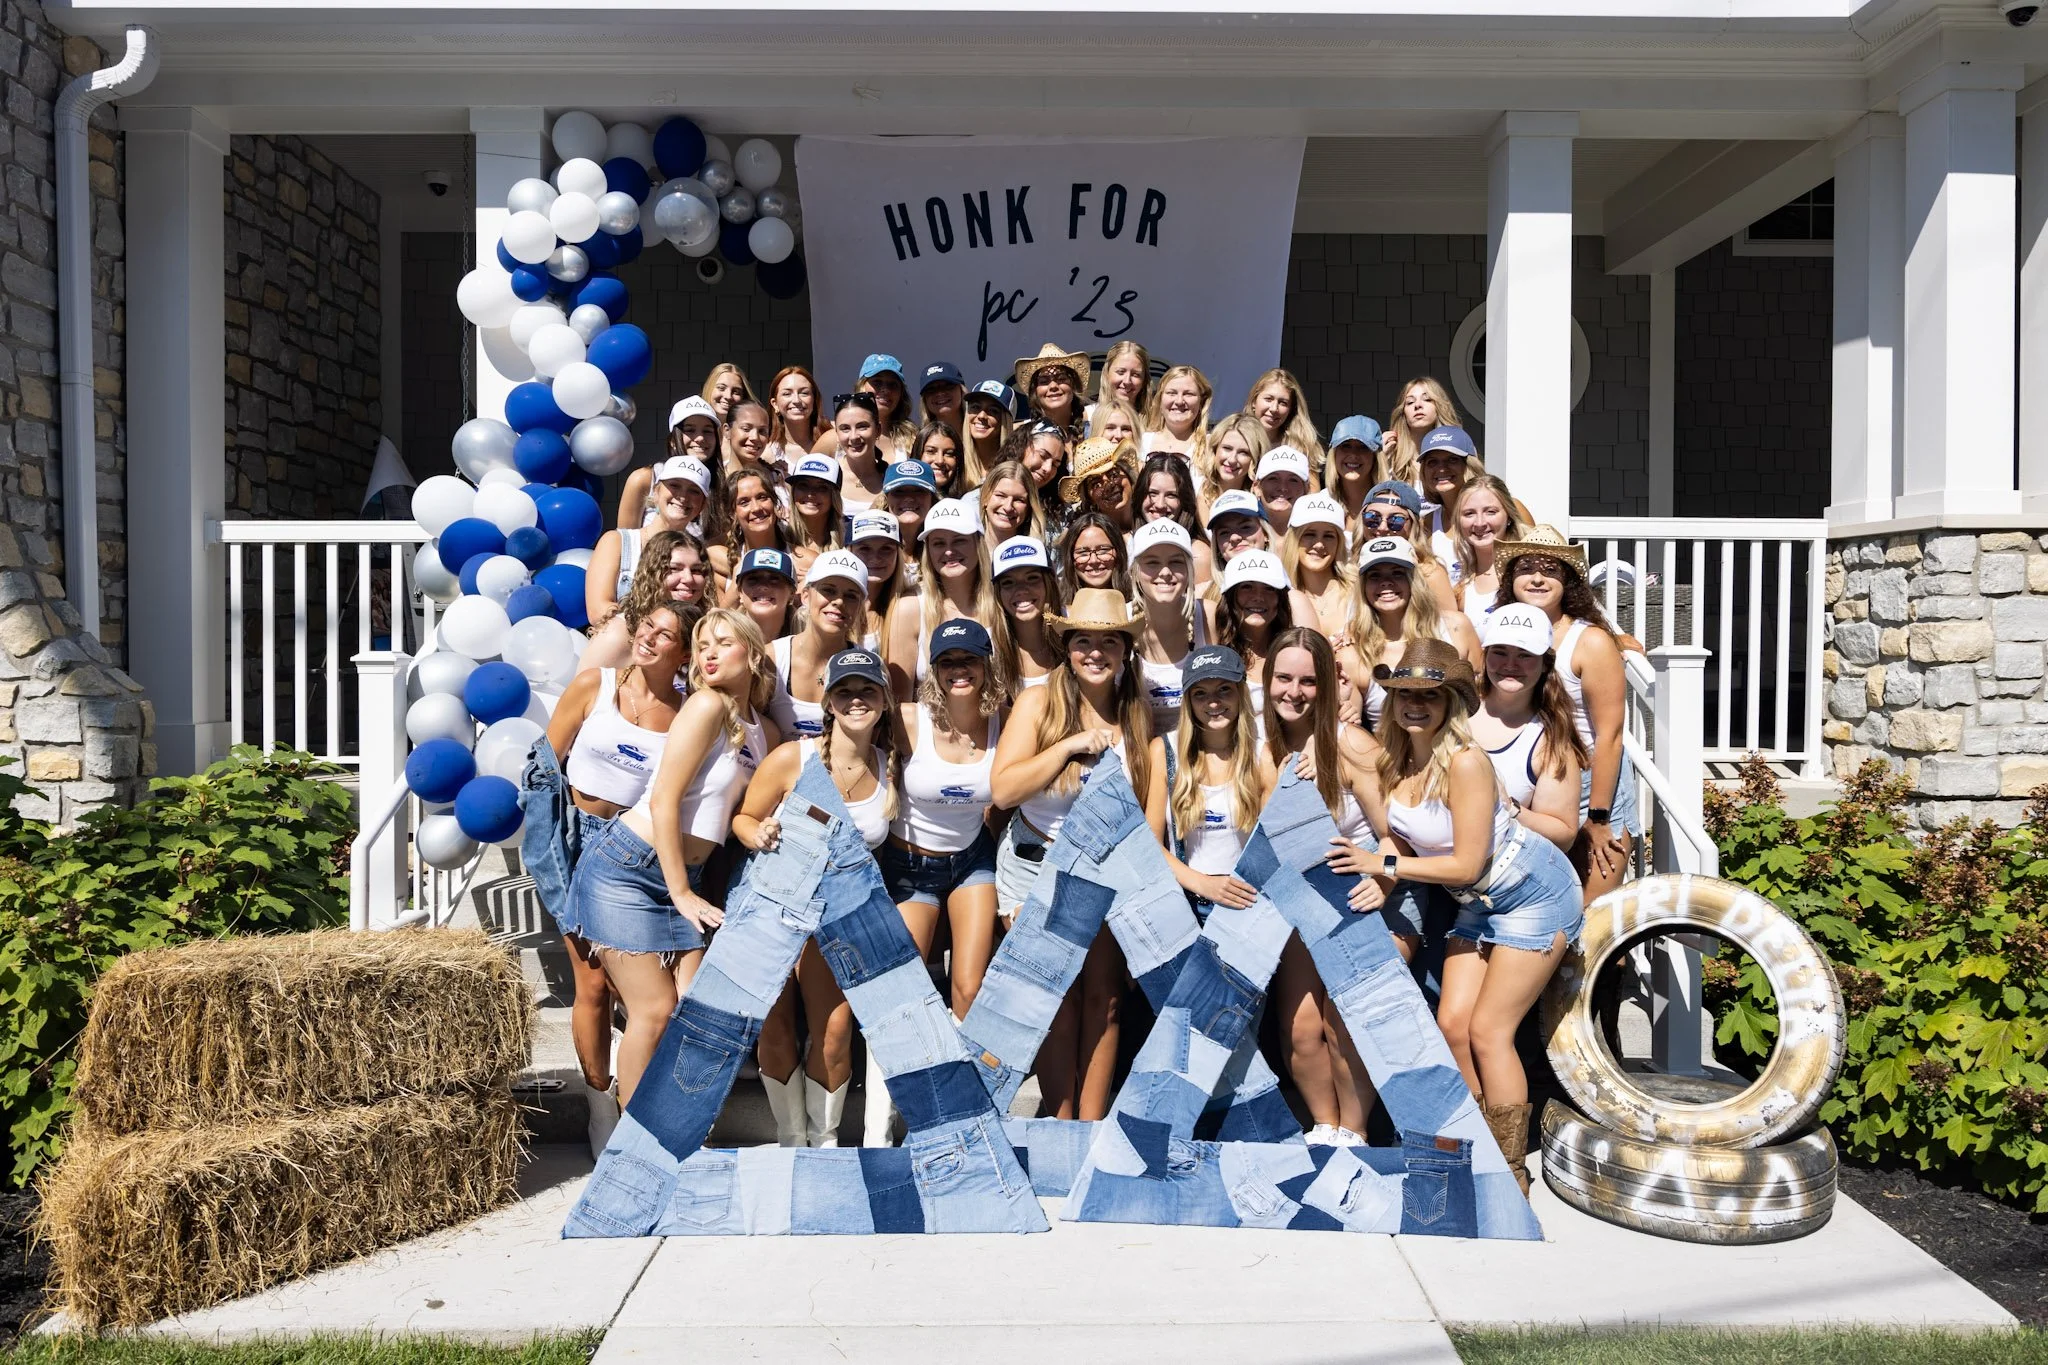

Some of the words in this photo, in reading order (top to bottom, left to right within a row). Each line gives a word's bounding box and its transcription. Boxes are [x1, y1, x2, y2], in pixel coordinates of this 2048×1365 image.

[882, 185, 1034, 261] HONK
[1068, 182, 1167, 248] FOR
[976, 280, 1039, 362] pc
[1068, 266, 1139, 339] '23
[1429, 432, 1453, 444] Ford
[1013, 546, 1035, 556] Delta
[1371, 542, 1394, 552] Ford
[942, 626, 966, 638] Ford
[843, 653, 868, 664] Ford
[1191, 653, 1222, 670] Ford
[623, 758, 645, 771] Delta
[1590, 873, 1691, 938] TRI
